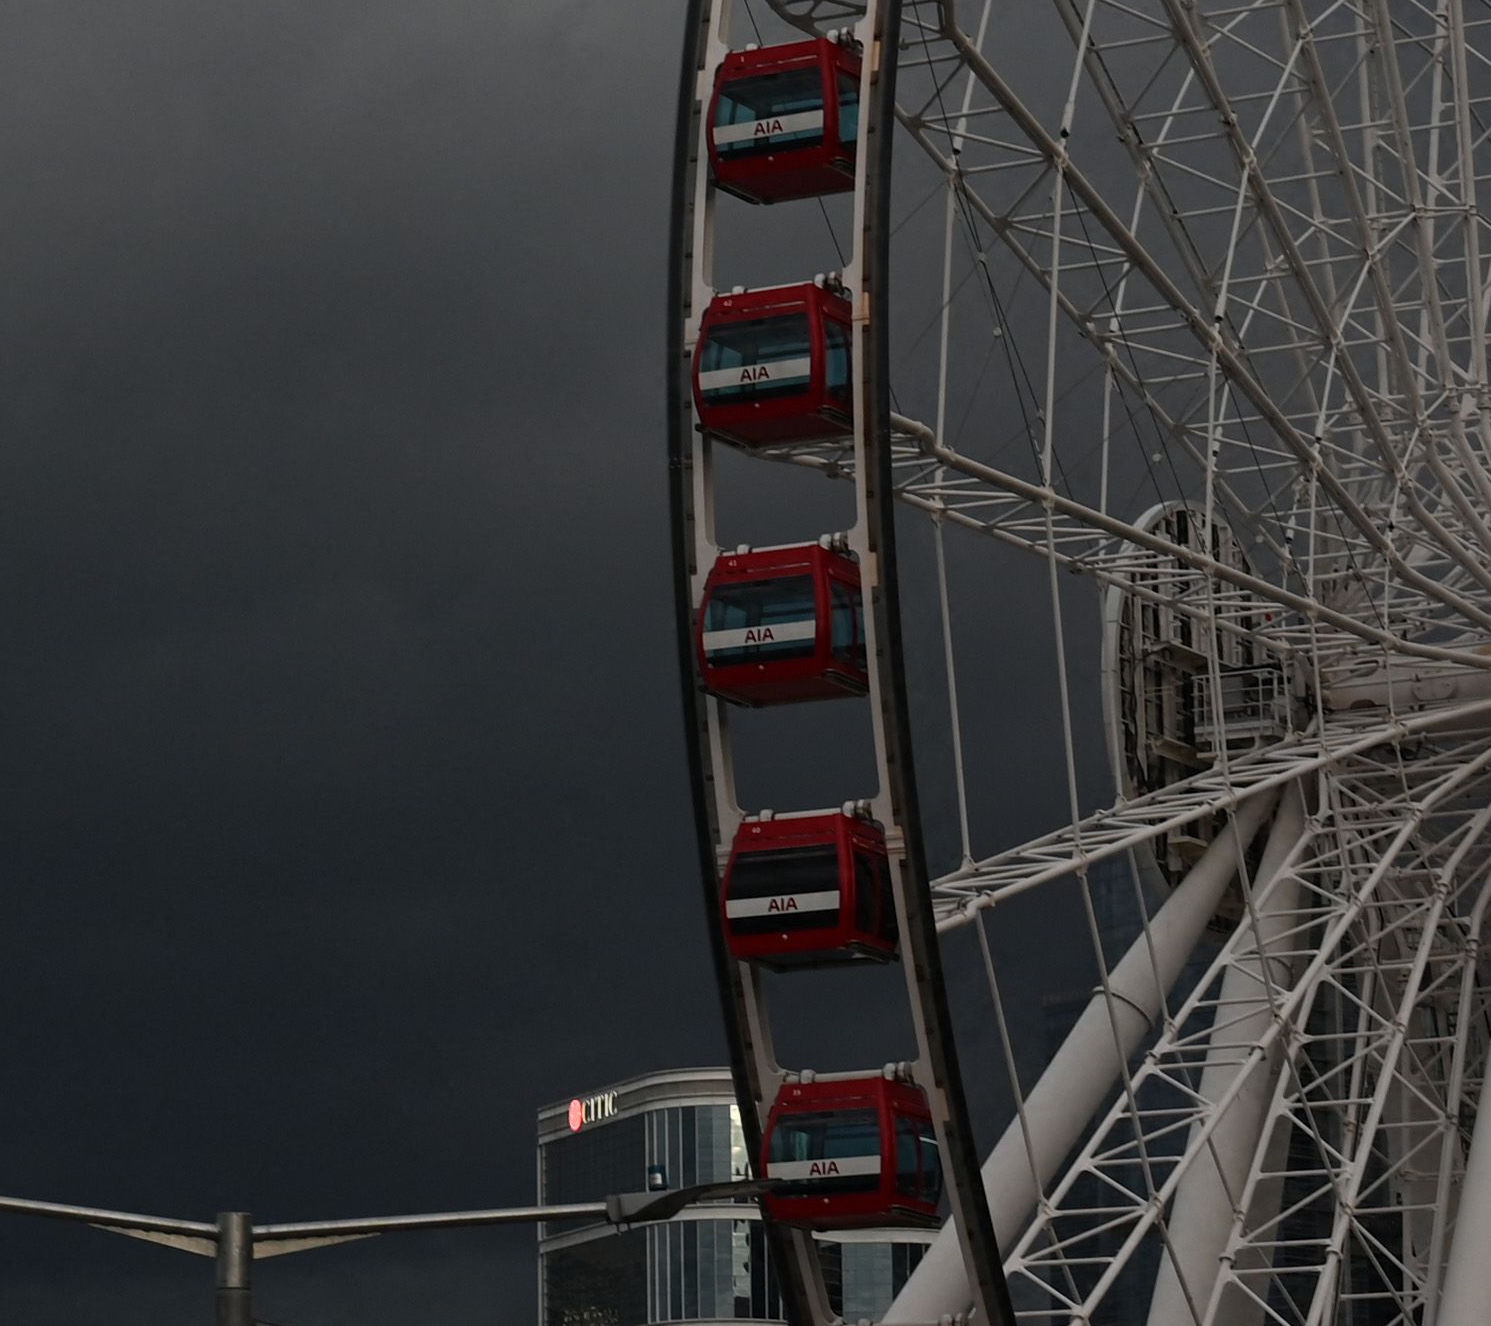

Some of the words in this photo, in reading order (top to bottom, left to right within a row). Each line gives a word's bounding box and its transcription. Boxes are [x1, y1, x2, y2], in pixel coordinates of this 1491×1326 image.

[754, 119, 783, 136] AIA
[741, 366, 770, 382] AIA
[745, 628, 774, 643] AIA
[768, 897, 798, 912] AIA
[582, 1090, 618, 1124] CITIC
[810, 1161, 840, 1176] AIA
